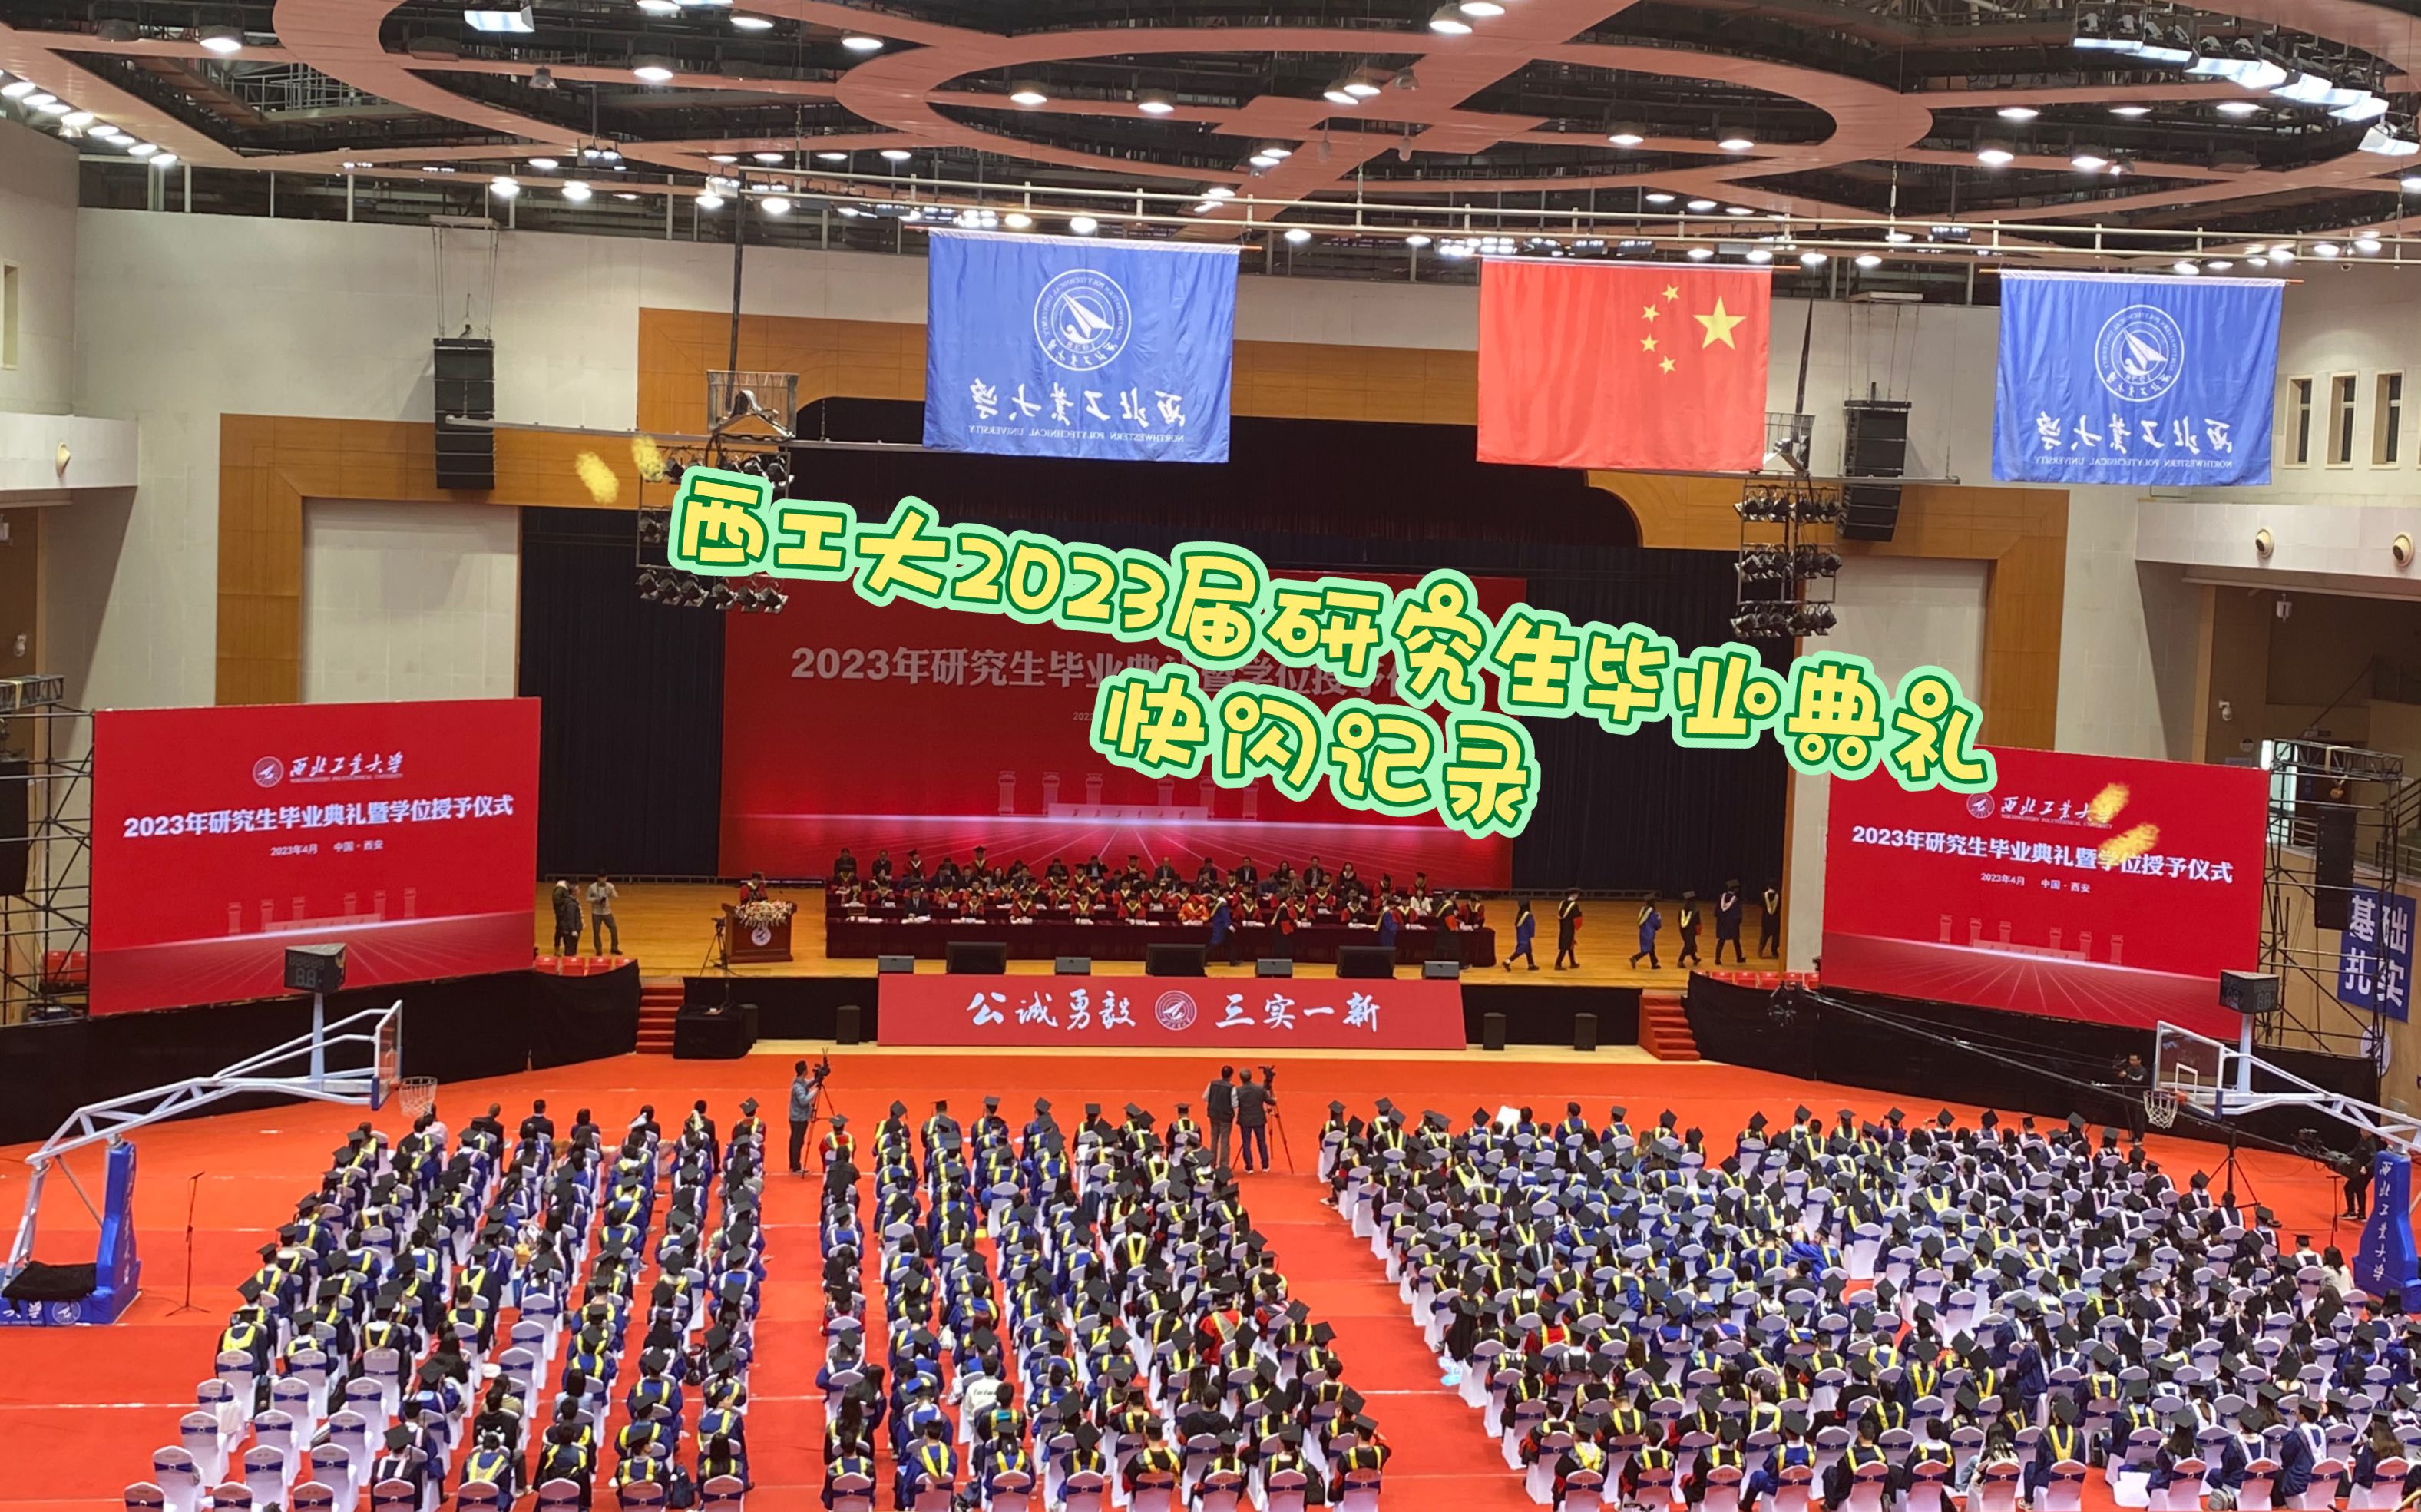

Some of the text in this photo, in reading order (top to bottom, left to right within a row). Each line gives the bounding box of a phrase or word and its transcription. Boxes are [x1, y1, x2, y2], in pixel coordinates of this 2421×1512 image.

[123, 794, 514, 839] 2023年研究生毕业典礼暨学位授予仪式
[270, 843, 318, 856] 2023年4月
[1852, 825, 2234, 884] 2023年研究生毕业典礼暨学位授予仪式
[1980, 872, 2025, 886] 2023年4月
[2349, 895, 2408, 955] 基础
[2345, 947, 2405, 1007] 扎实
[966, 988, 1381, 1032] 公诚勇毅 三实一新
